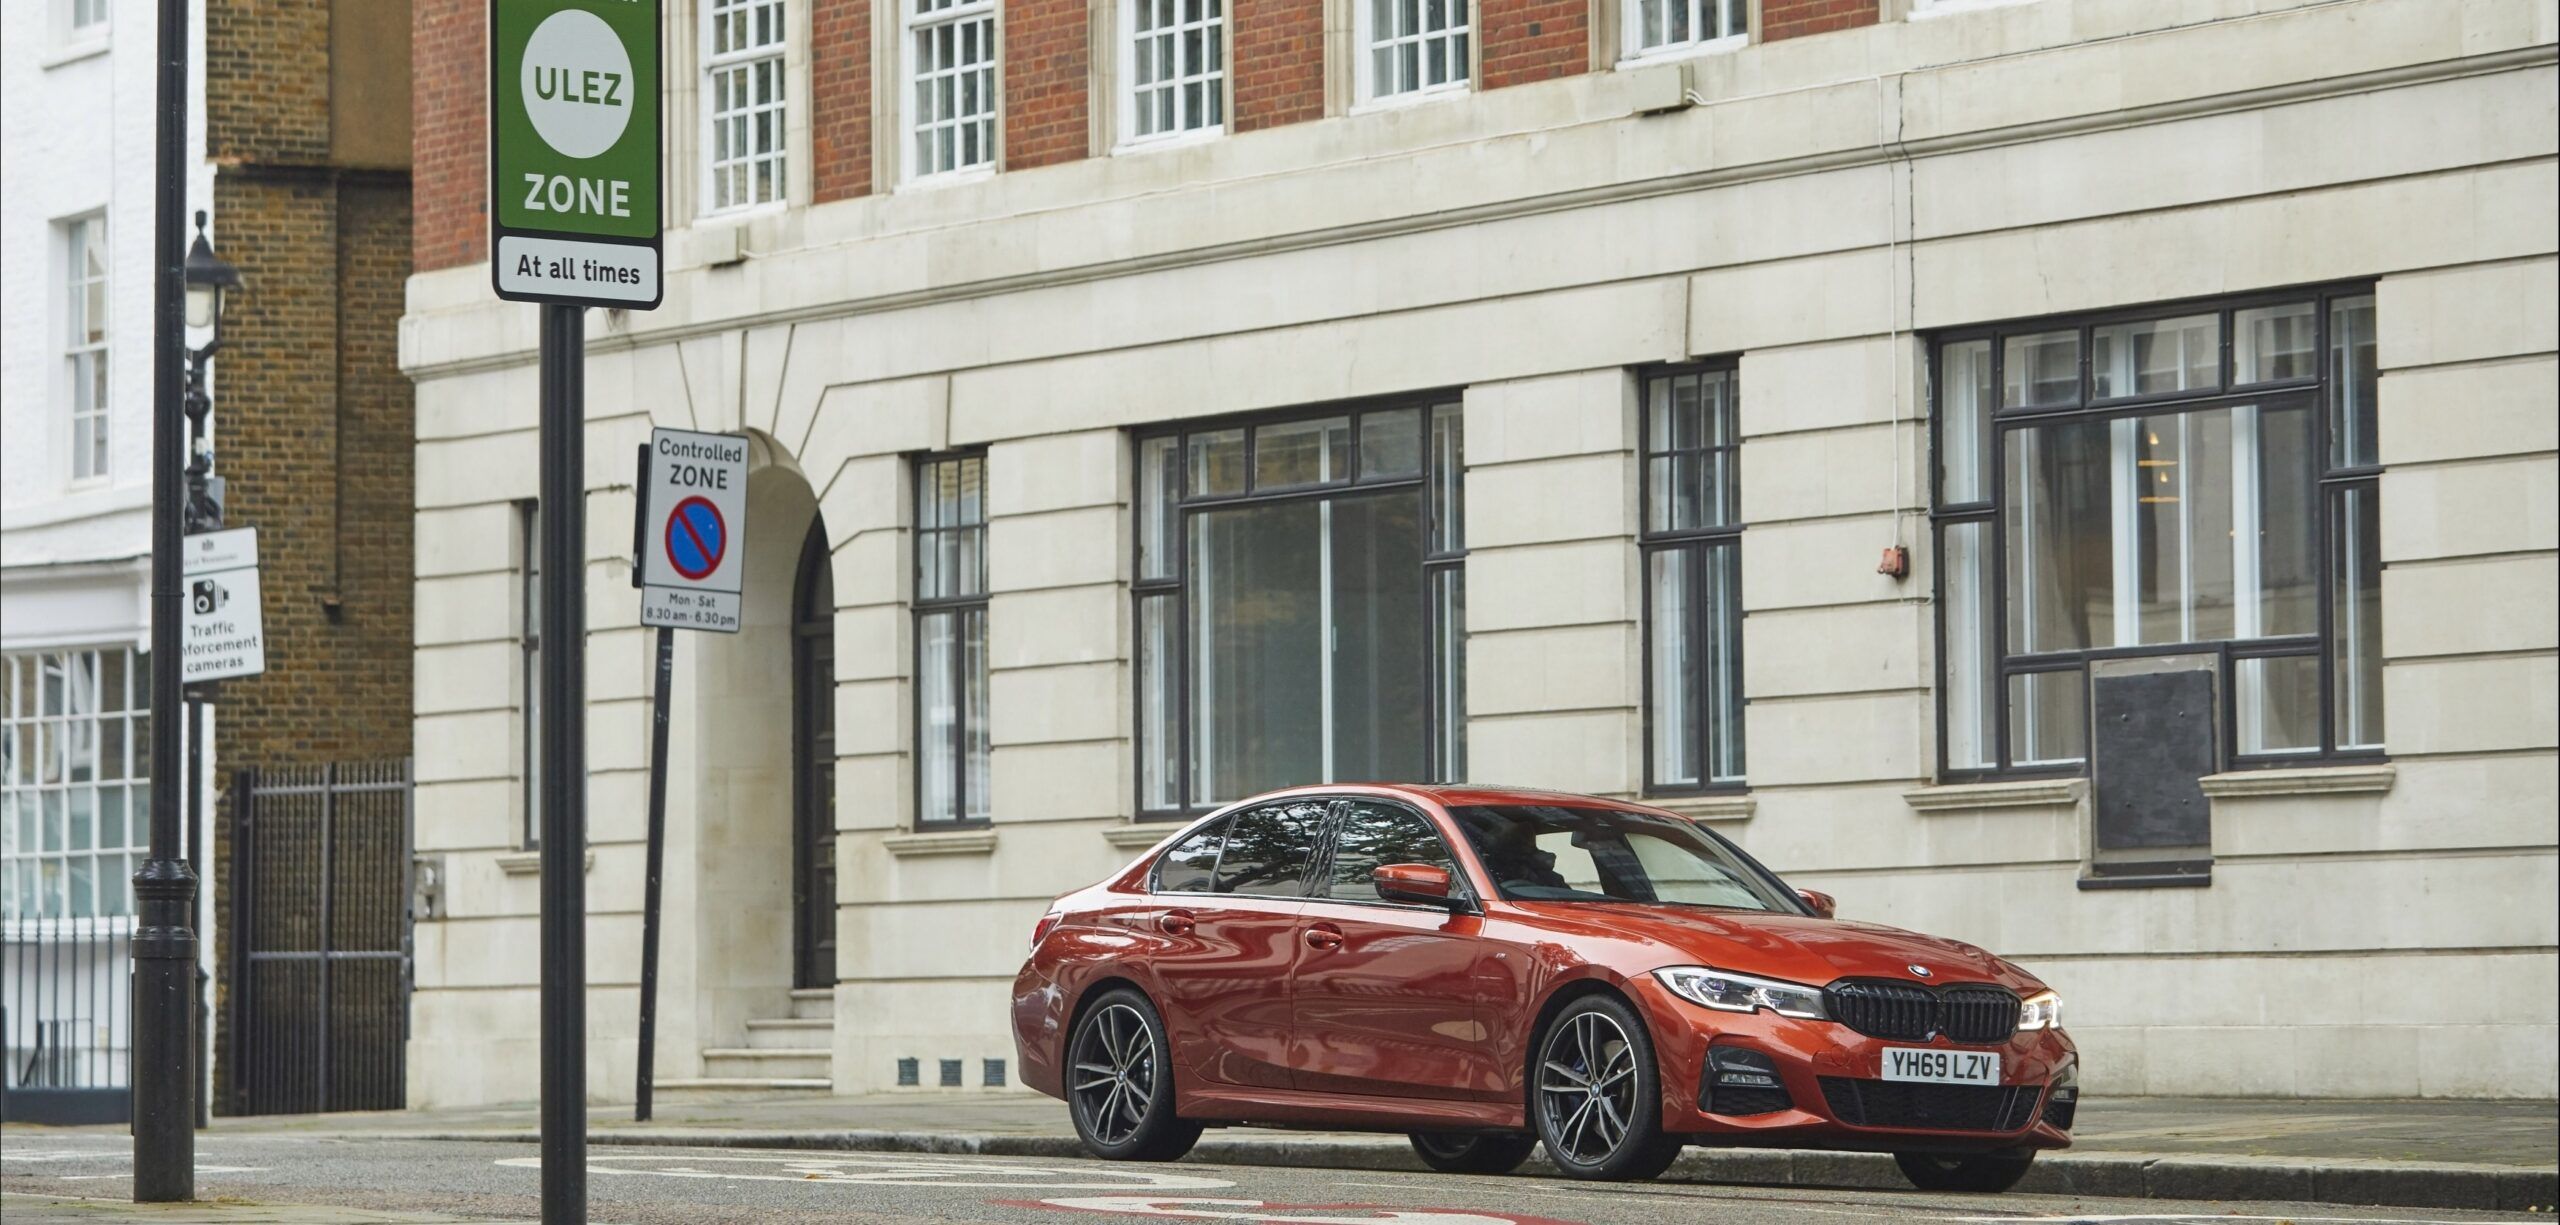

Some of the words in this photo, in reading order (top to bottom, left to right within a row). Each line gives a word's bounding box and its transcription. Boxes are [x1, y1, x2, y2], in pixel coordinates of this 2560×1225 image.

[535, 66, 622, 106] ULEZ
[524, 173, 631, 217] ZONE
[517, 254, 542, 278] At
[549, 257, 576, 280] all
[583, 259, 640, 285] times
[659, 438, 742, 463] Controlled
[669, 464, 728, 490] ZONE
[669, 593, 690, 606] Mon
[698, 595, 715, 608] Sat
[190, 621, 235, 637] Traffic
[646, 607, 671, 620] 8.30
[672, 612, 688, 621] am
[695, 611, 719, 624] 6.30
[720, 616, 736, 626] pm
[183, 635, 258, 656] nforcement
[186, 656, 244, 674] cameras
[1892, 1051, 1948, 1078] YH69
[1953, 1054, 1991, 1080] LZV
